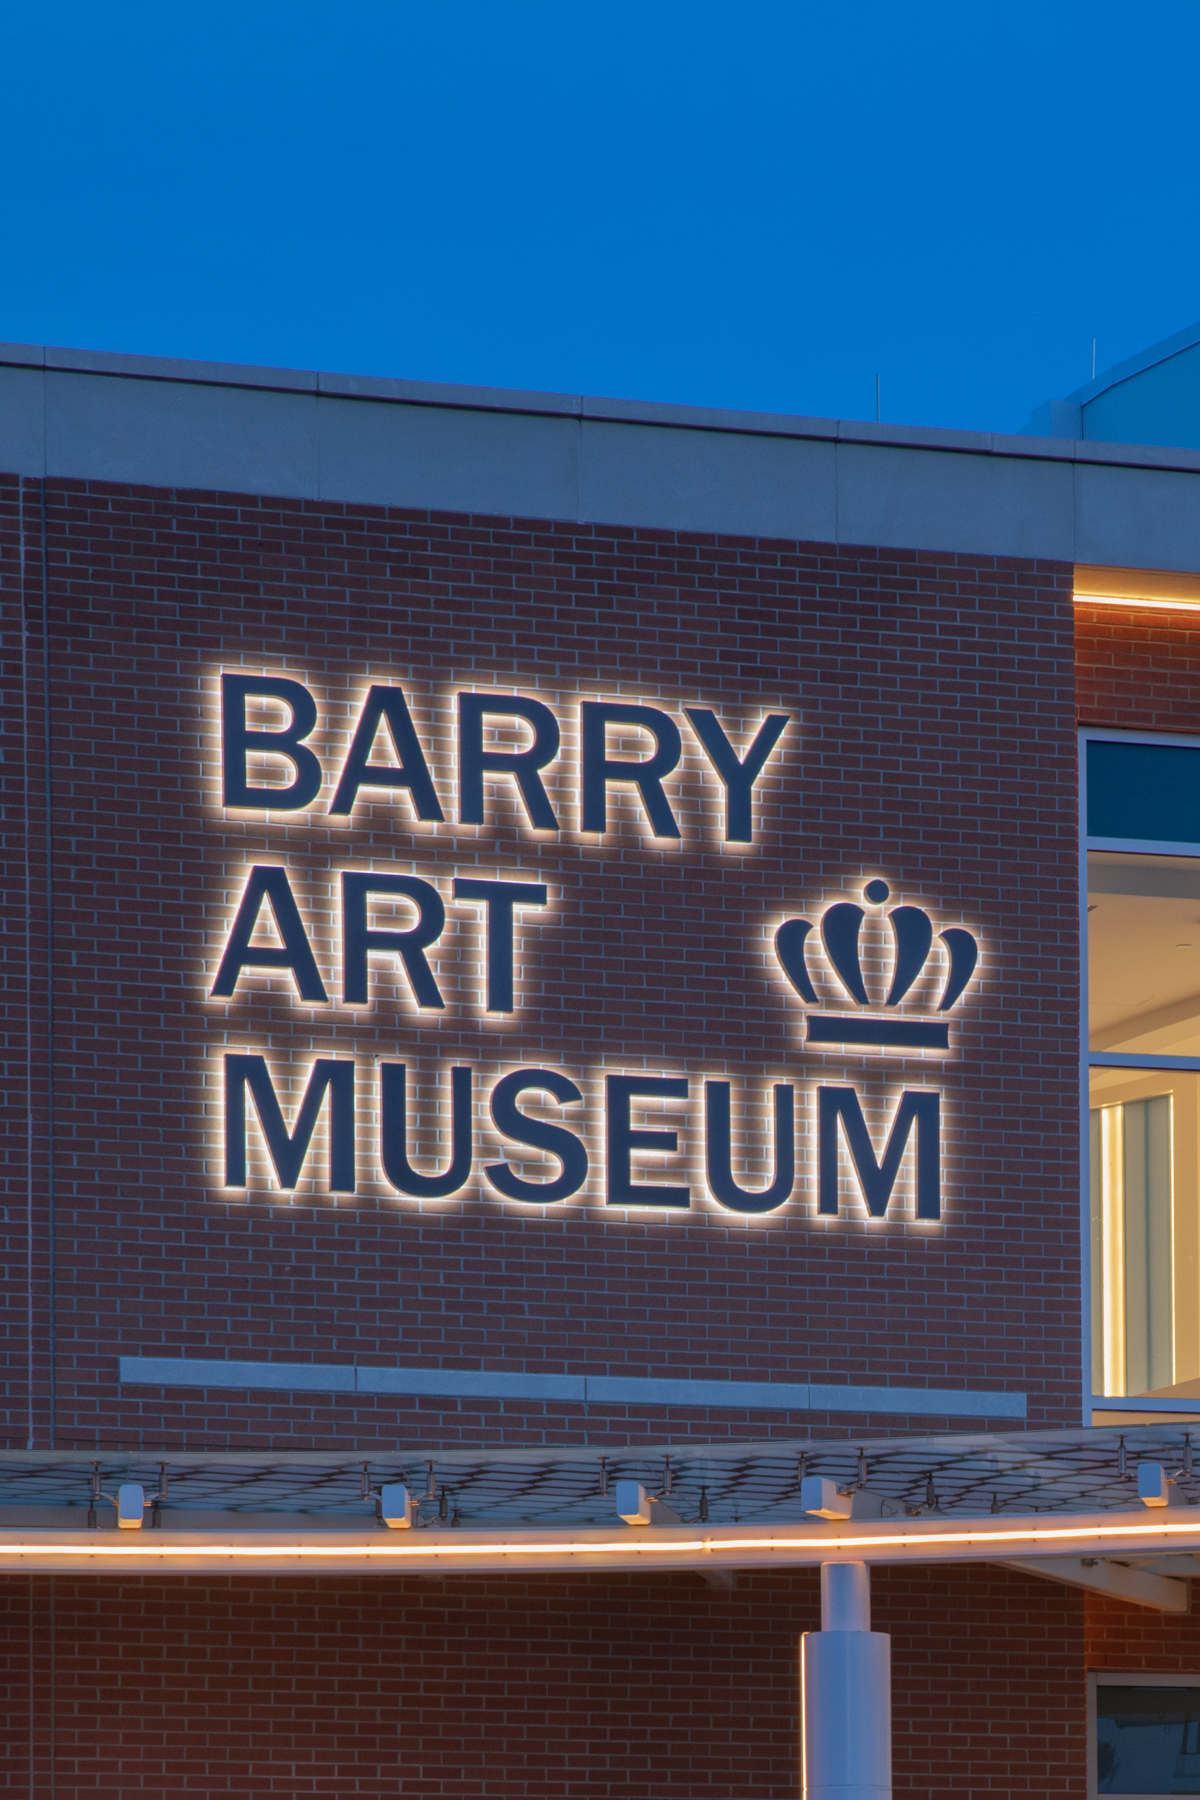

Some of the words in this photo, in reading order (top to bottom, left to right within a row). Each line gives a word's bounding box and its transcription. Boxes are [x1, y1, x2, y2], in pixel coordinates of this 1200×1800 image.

[220, 672, 791, 843] BARRY
[209, 864, 548, 1014] ART
[223, 1053, 941, 1221] MUSEUM
